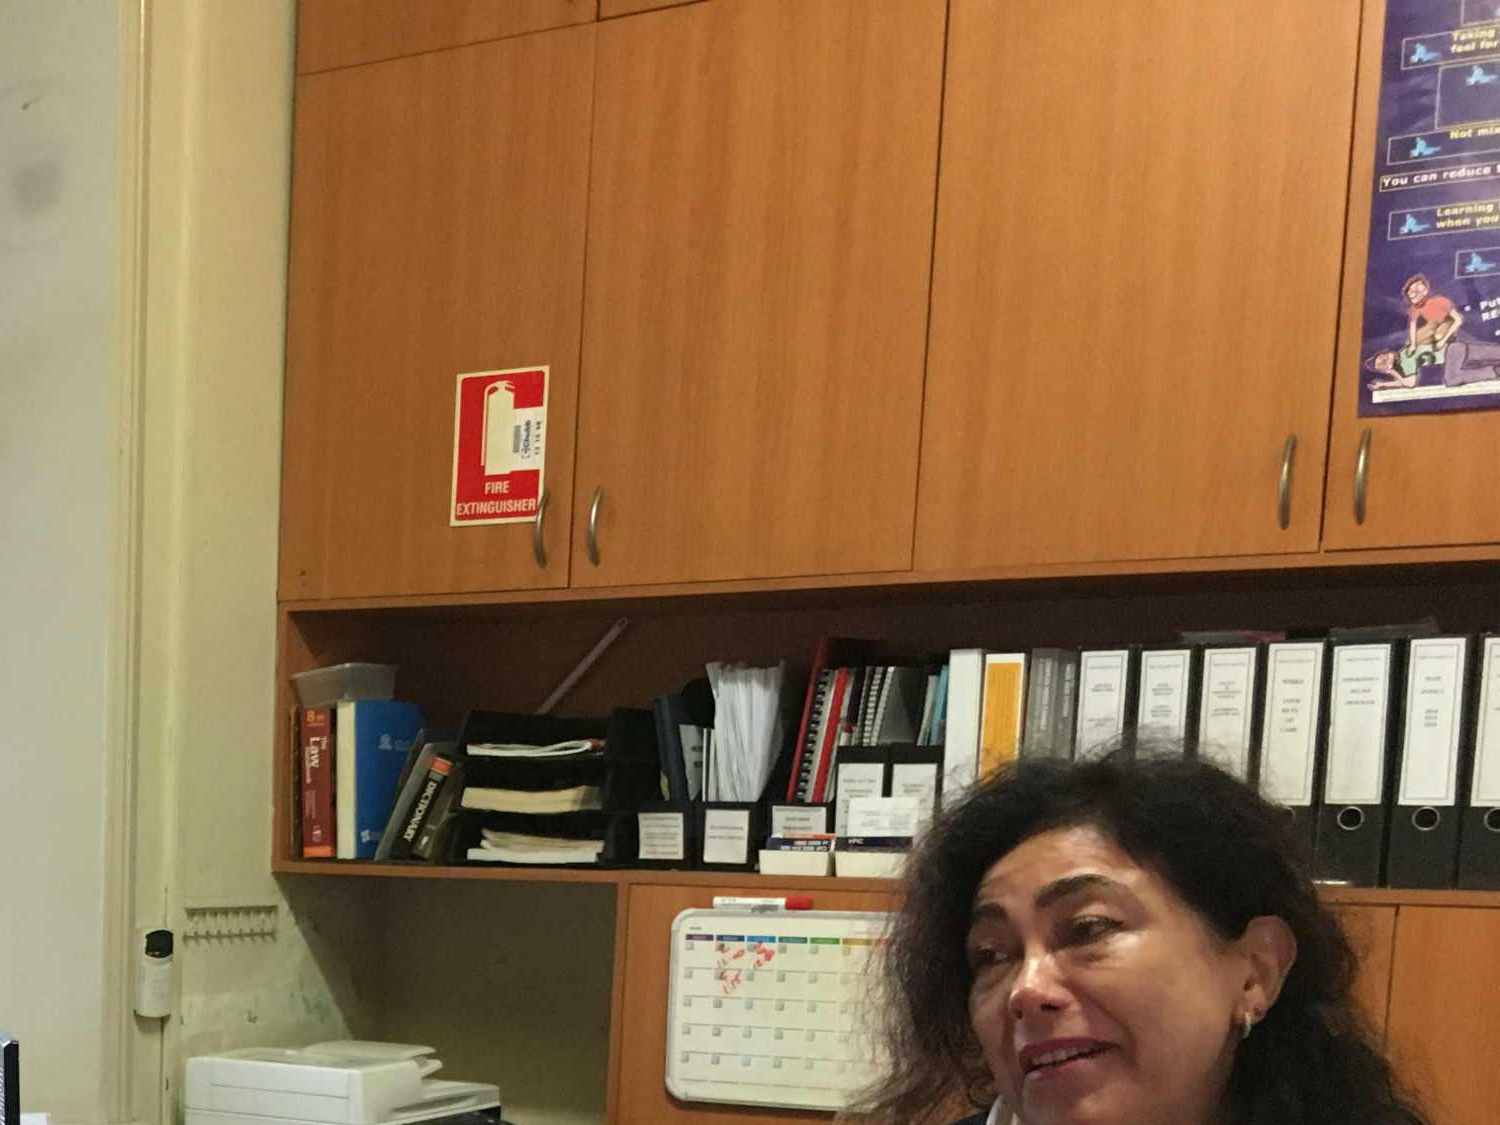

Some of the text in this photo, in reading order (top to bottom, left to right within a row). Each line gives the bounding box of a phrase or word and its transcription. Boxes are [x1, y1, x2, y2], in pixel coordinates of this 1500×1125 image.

[1449, 128, 1473, 140] Not
[1383, 174, 1408, 187] You
[1413, 173, 1438, 185] can
[1442, 165, 1492, 179] reduce
[1436, 202, 1495, 217] Learning
[1436, 217, 1471, 229] when
[484, 480, 510, 495] FIRE
[456, 498, 537, 516] EXTINGUISHER
[309, 736, 321, 768] Law
[403, 781, 438, 842] DICTIONARY
